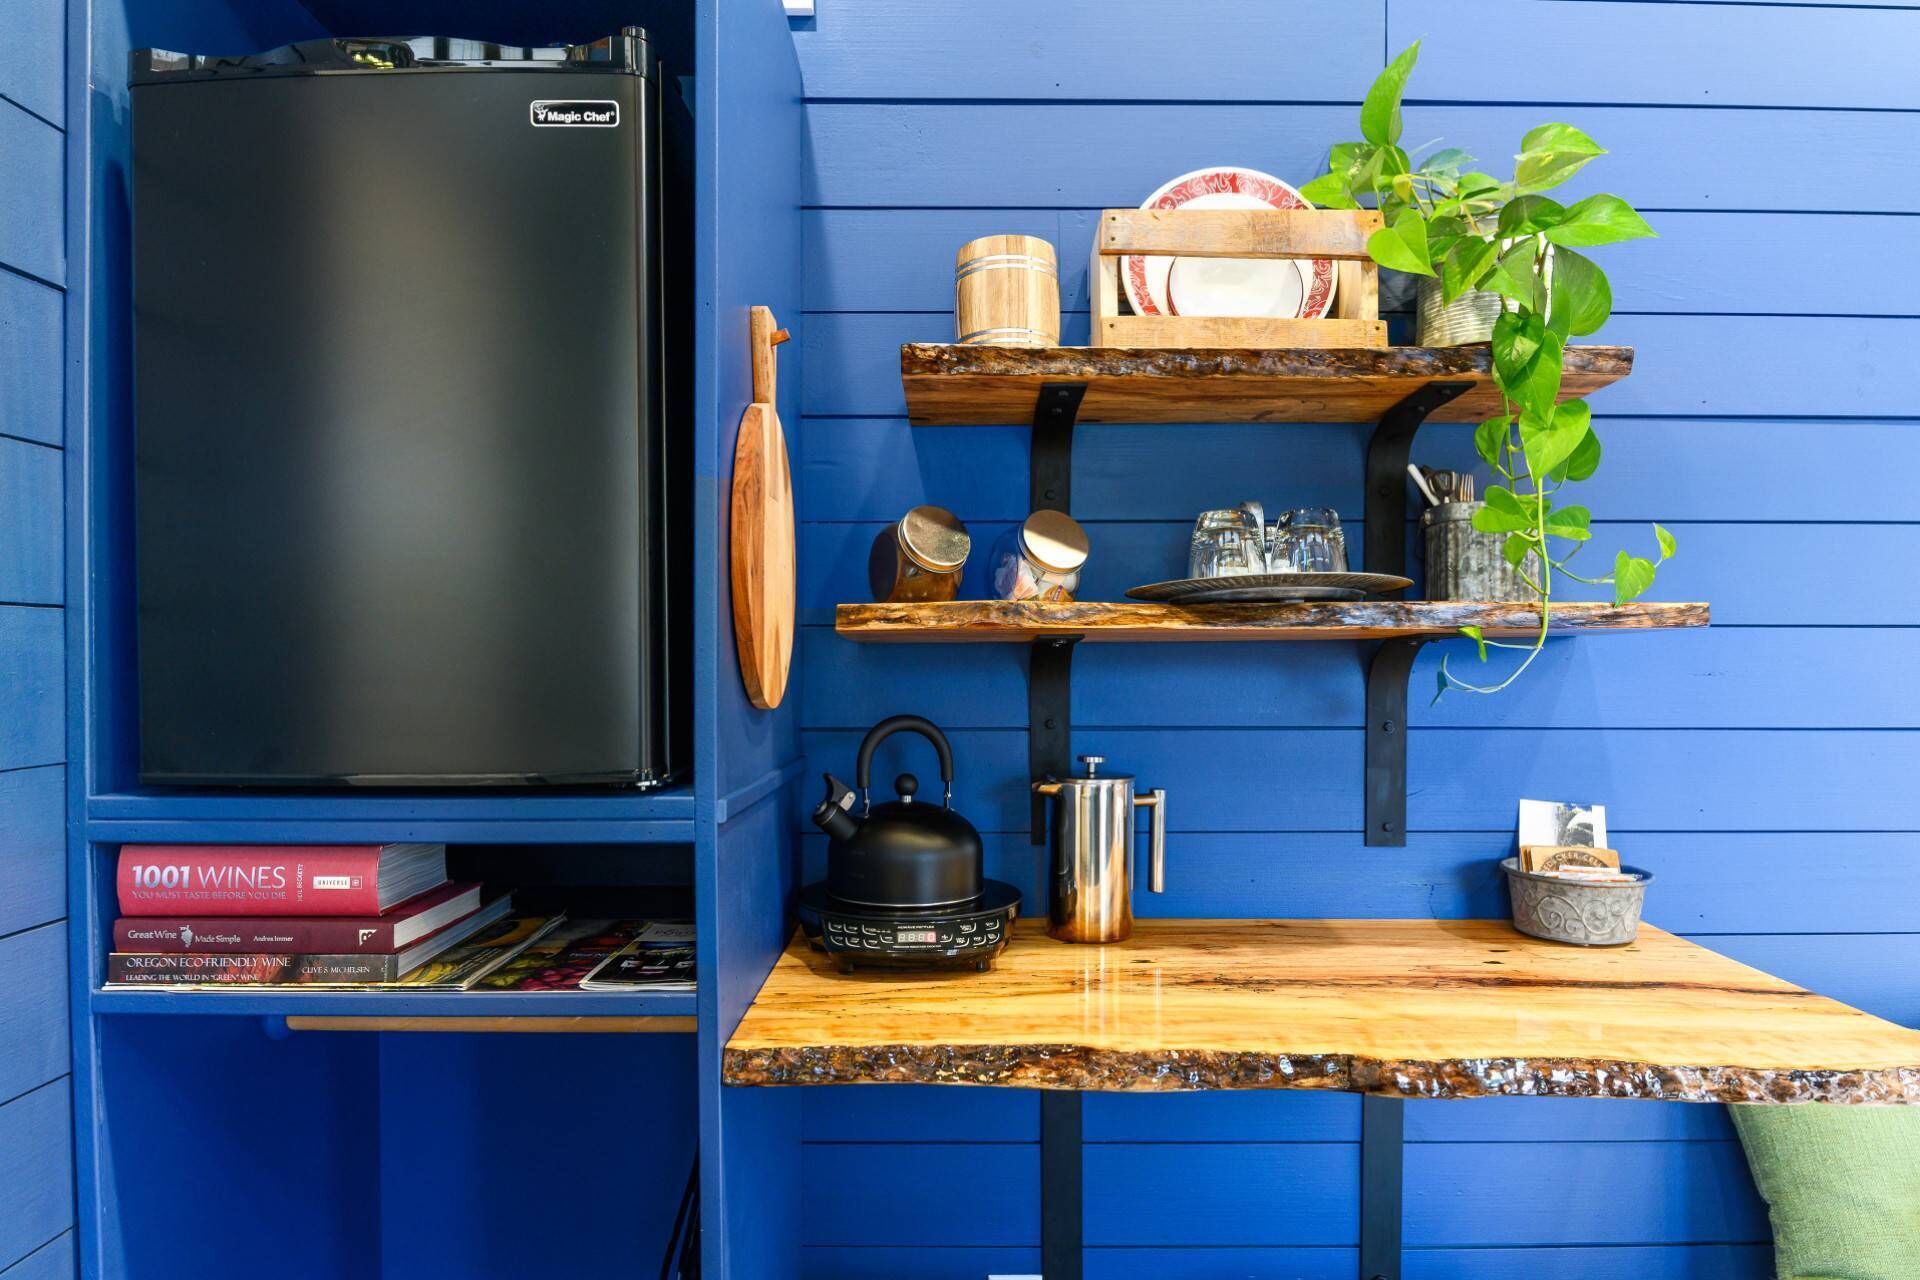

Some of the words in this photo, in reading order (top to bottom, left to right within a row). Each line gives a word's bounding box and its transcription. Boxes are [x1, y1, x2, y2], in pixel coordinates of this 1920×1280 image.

[547, 110, 581, 123] Magic
[583, 110, 611, 122] Chef
[132, 865, 190, 889] 1001
[197, 865, 286, 889] WINES
[132, 890, 153, 900] YOU
[156, 890, 181, 900] MUST
[184, 890, 210, 900] TASTE
[212, 890, 246, 900] BEFORE
[248, 890, 270, 900] YOU
[271, 890, 287, 900] DIE
[128, 930, 154, 939] Great
[153, 930, 177, 939] Wine
[195, 934, 215, 943] Made
[216, 933, 241, 945] Simple
[126, 957, 177, 968] OREGON
[179, 957, 259, 968] ECO-FRIENDLY
[261, 957, 291, 968] WINE
[302, 966, 324, 974] CLIVE
[330, 966, 370, 974] MICHELSEN
[125, 974, 156, 982] LEADING
[158, 974, 172, 982] THE
[172, 974, 199, 982] WORLD
[201, 974, 209, 982] IN
[240, 974, 258, 982] WINE
